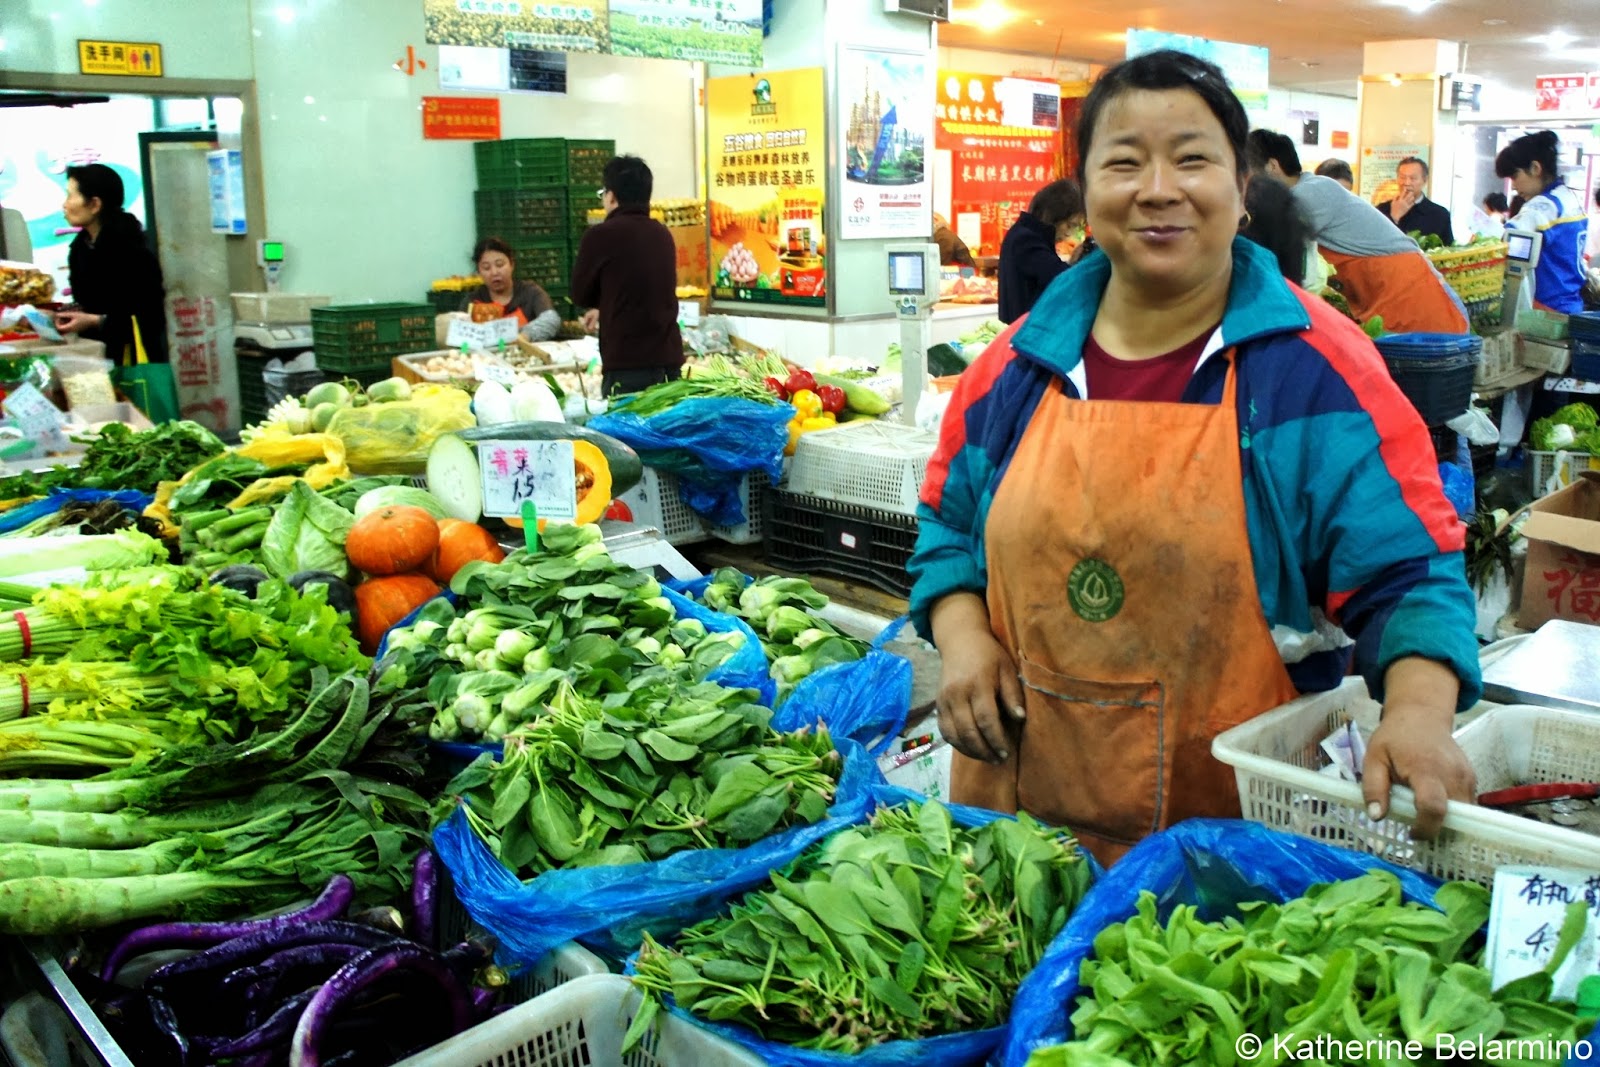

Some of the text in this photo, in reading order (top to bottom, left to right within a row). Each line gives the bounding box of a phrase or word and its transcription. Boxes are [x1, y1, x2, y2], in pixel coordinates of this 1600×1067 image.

[86, 45, 124, 61] 洗手间
[715, 168, 816, 187] 谷物鸡蛋就选圣迪乐
